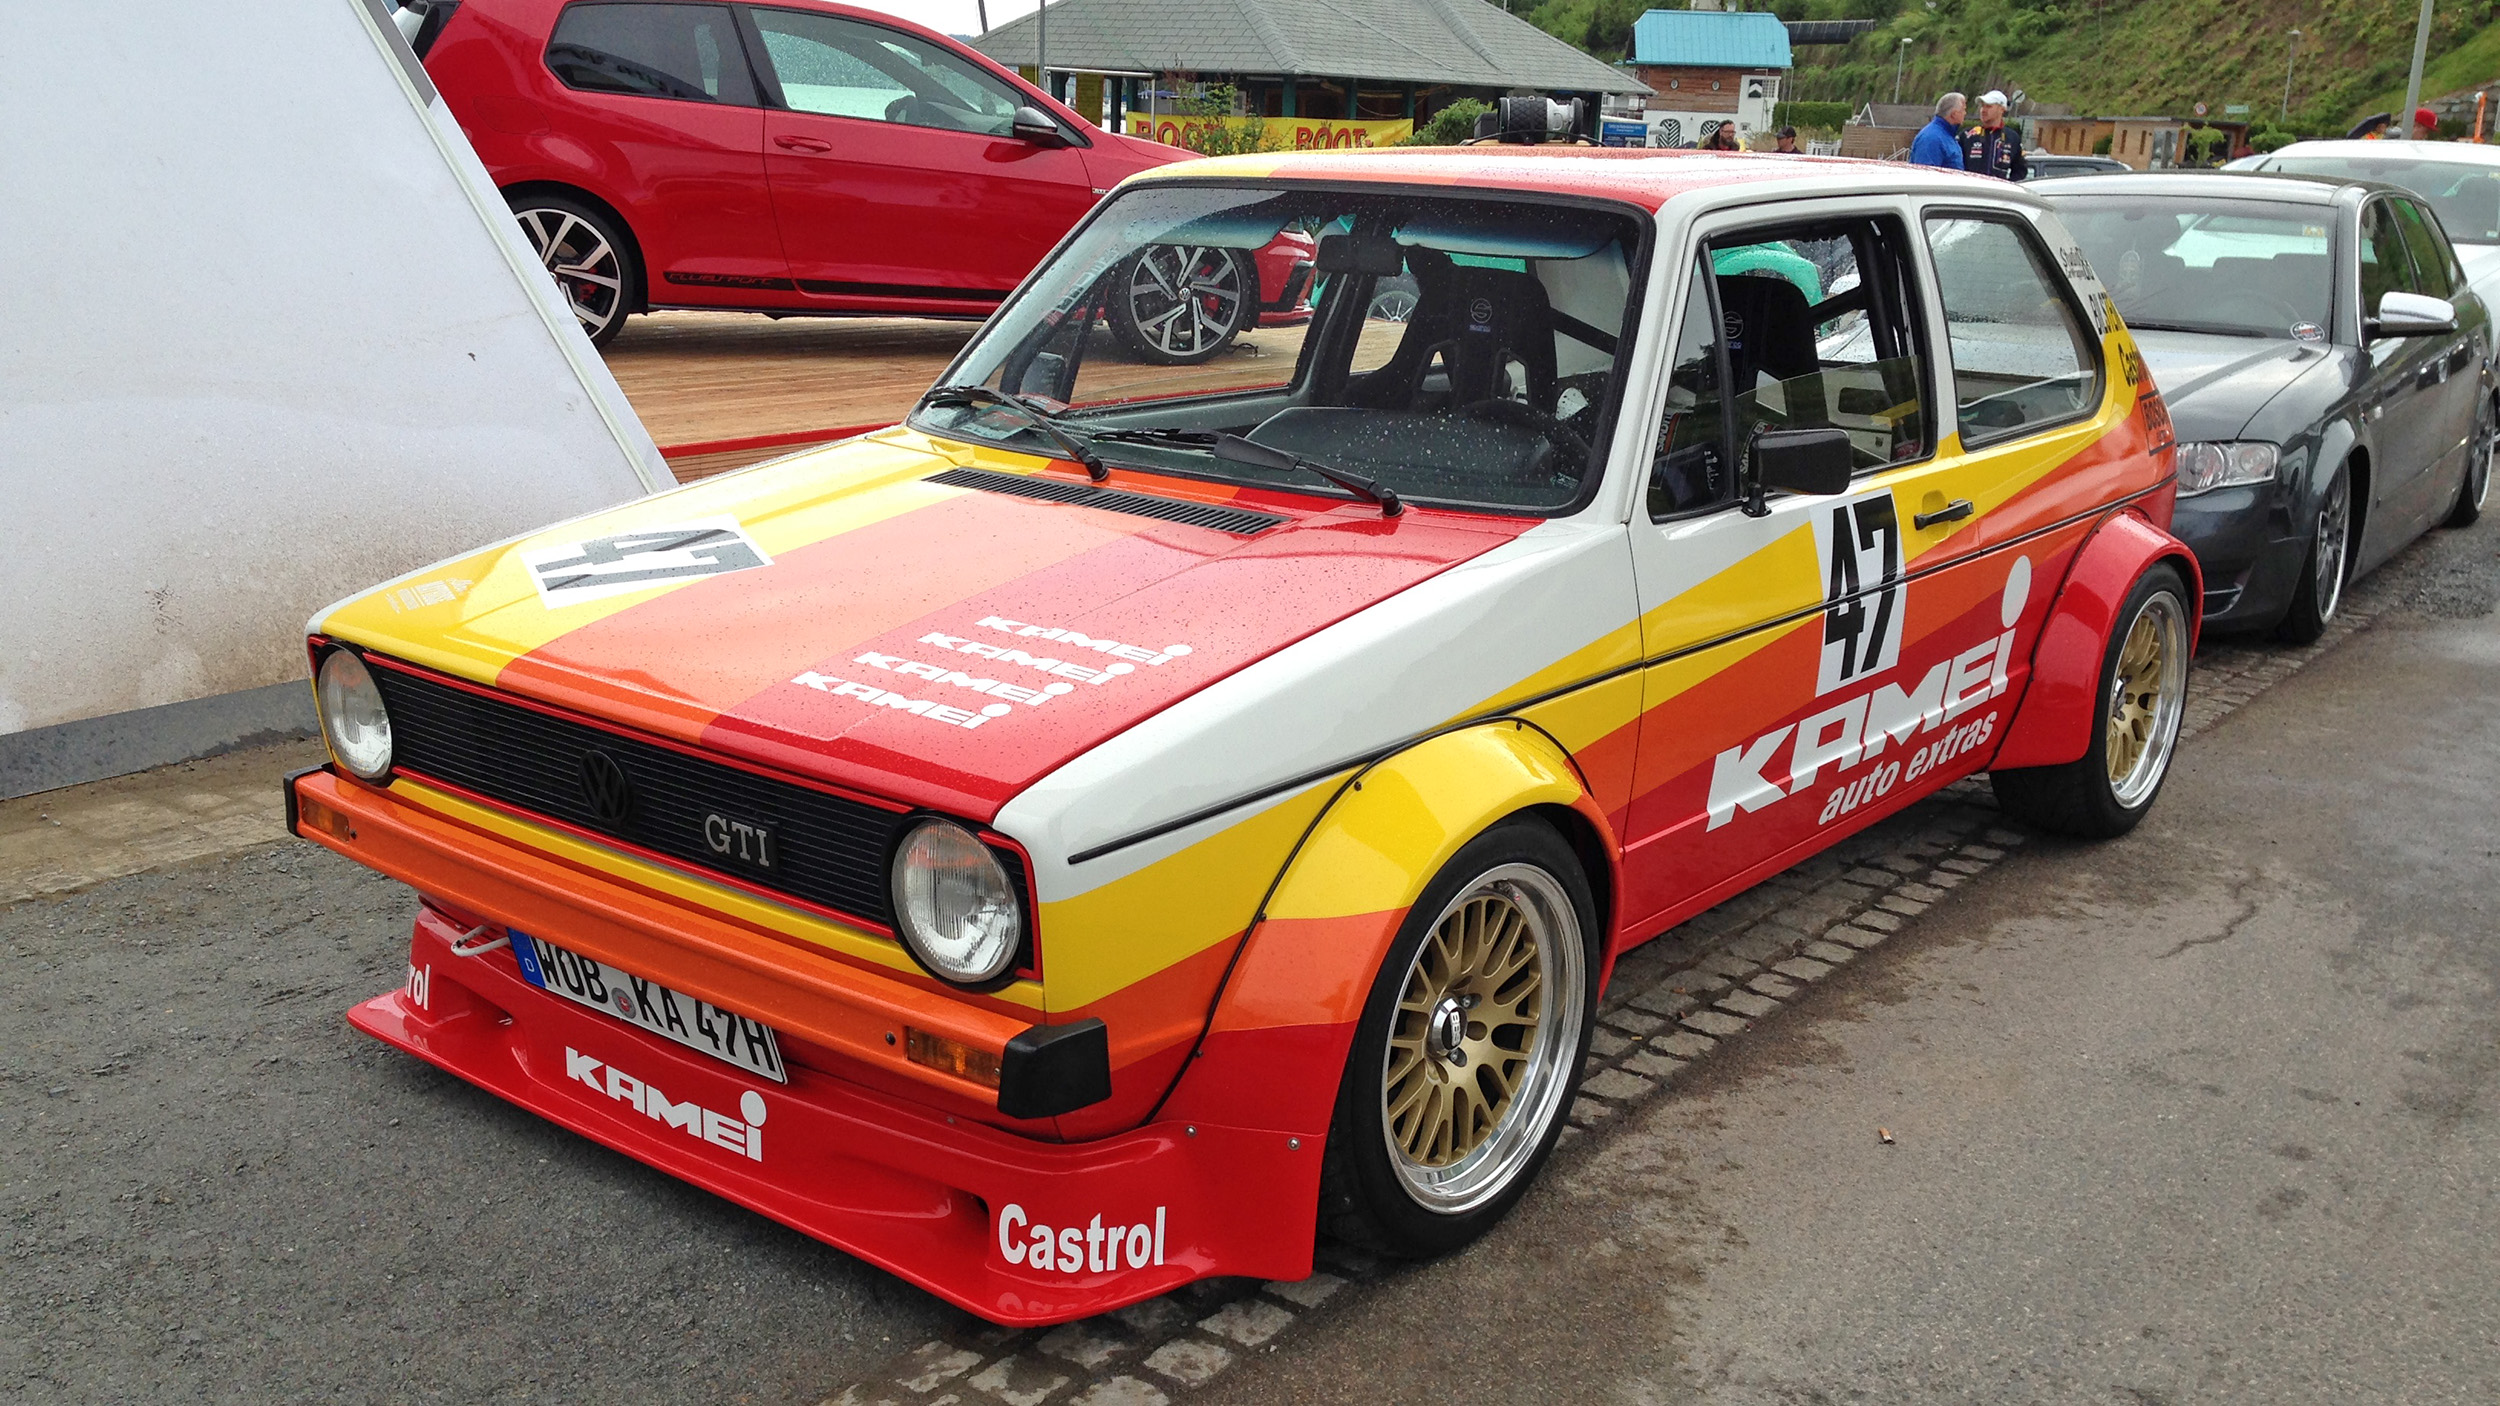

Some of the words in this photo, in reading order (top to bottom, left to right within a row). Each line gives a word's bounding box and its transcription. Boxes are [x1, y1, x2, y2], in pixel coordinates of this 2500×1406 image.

[535, 528, 765, 592] 47
[1824, 493, 1899, 682] 47
[1818, 760, 1900, 826] auto
[1905, 711, 1998, 783] extras
[704, 813, 770, 868] GTI
[531, 936, 609, 1004] WOB
[628, 973, 690, 1038] KA
[1450, 1011, 1461, 1047] BBS
[999, 1203, 1167, 1274] Castrol
